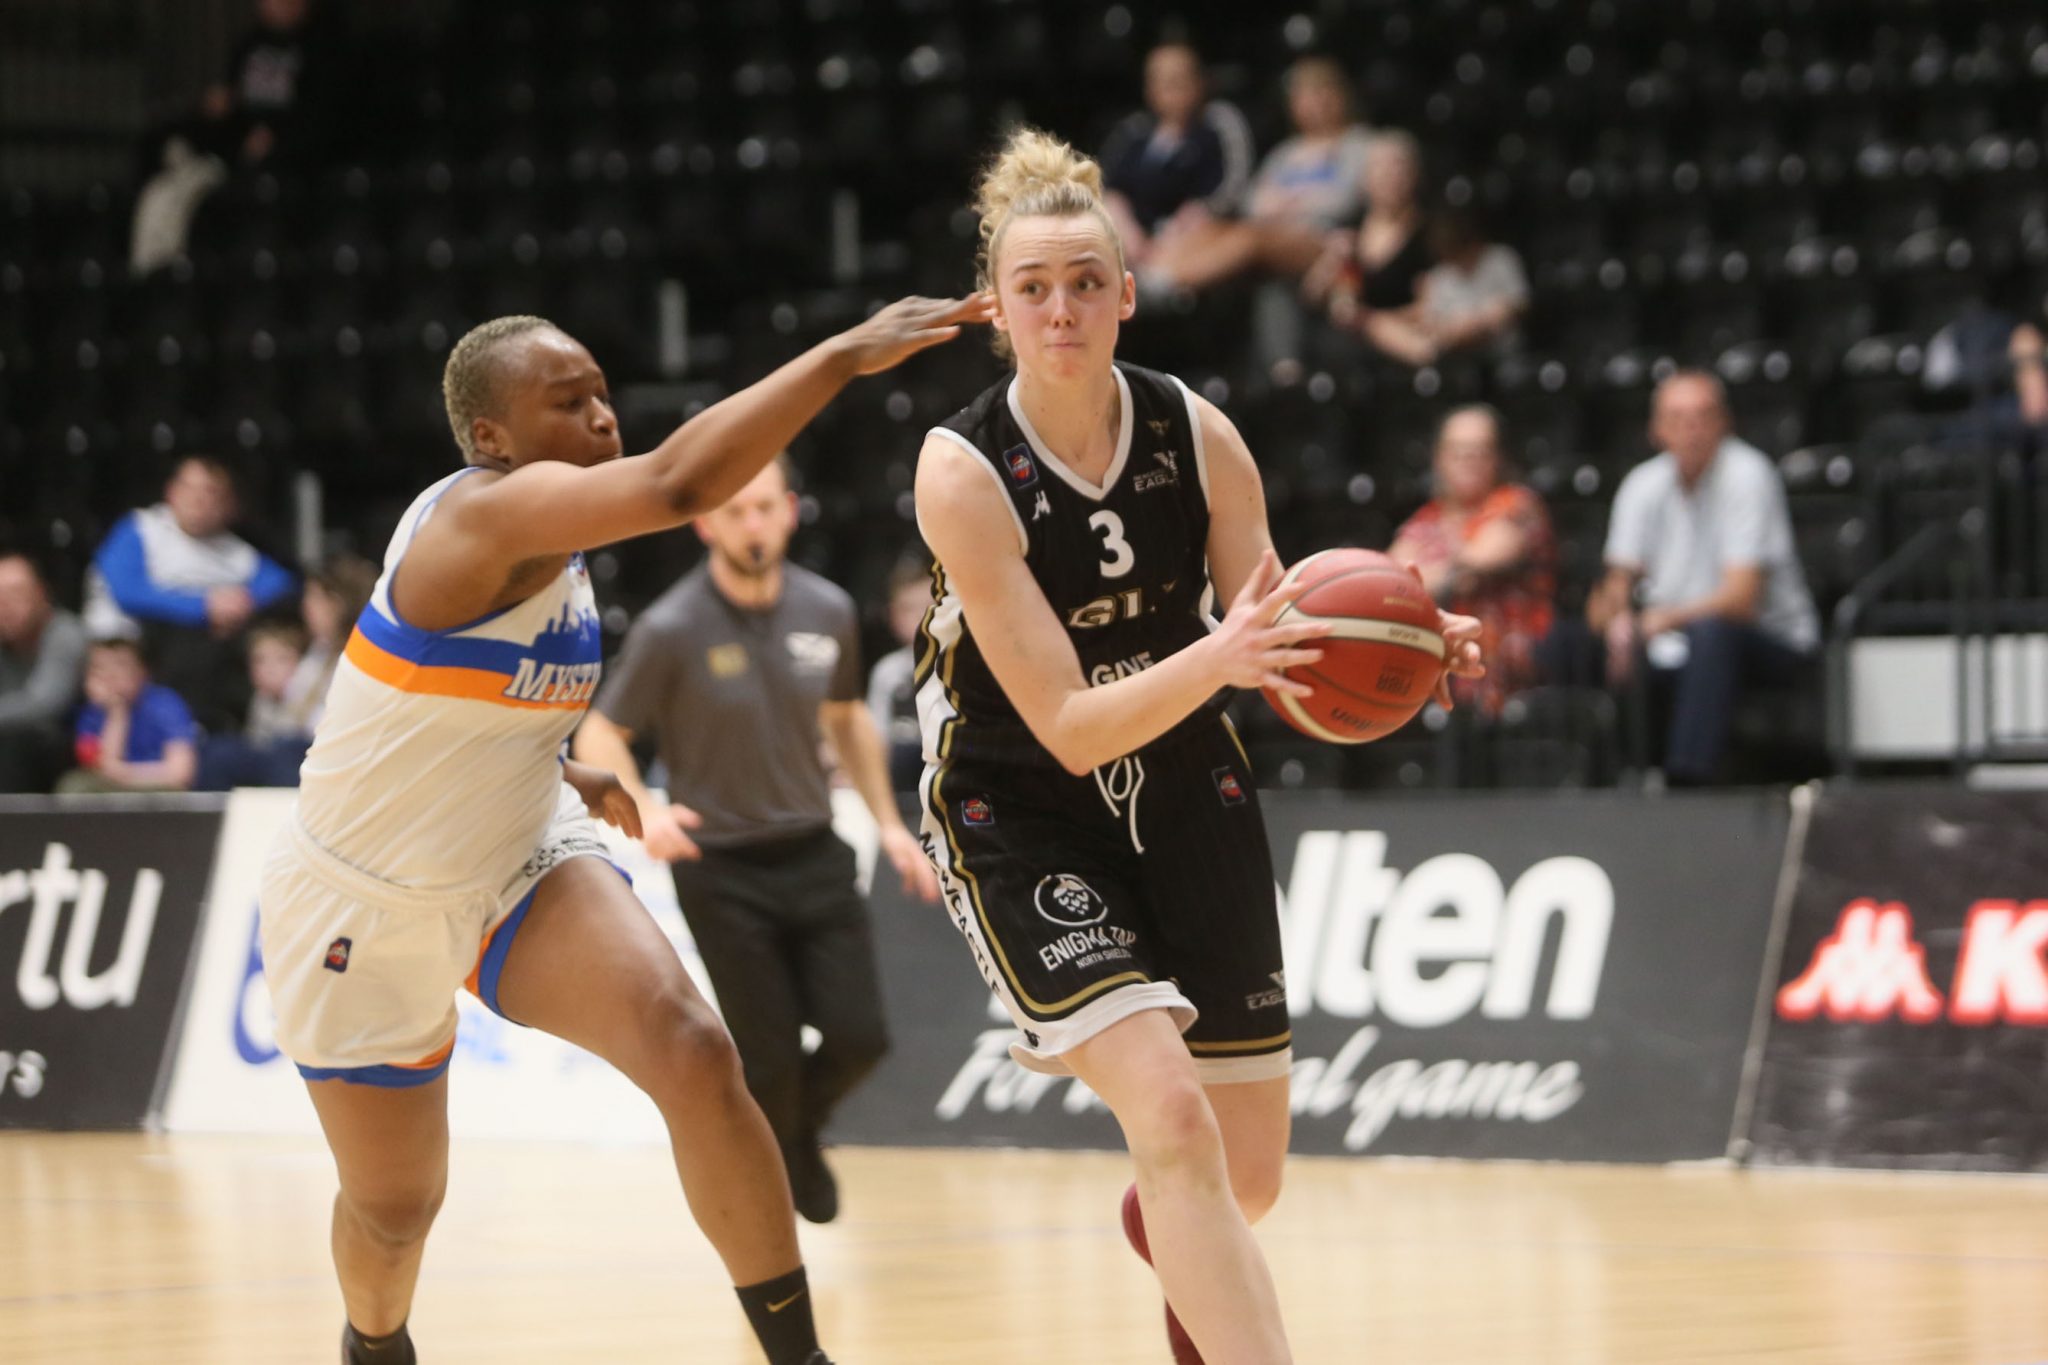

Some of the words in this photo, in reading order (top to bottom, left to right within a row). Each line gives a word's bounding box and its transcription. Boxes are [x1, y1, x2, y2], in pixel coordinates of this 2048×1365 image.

[1088, 509, 1135, 578] 3
[503, 657, 602, 702] MYSTI
[1091, 651, 1153, 688] GIVE
[1038, 926, 1114, 971] ENIGMA
[1276, 829, 1615, 1028] lten
[1342, 1058, 1586, 1151] game
